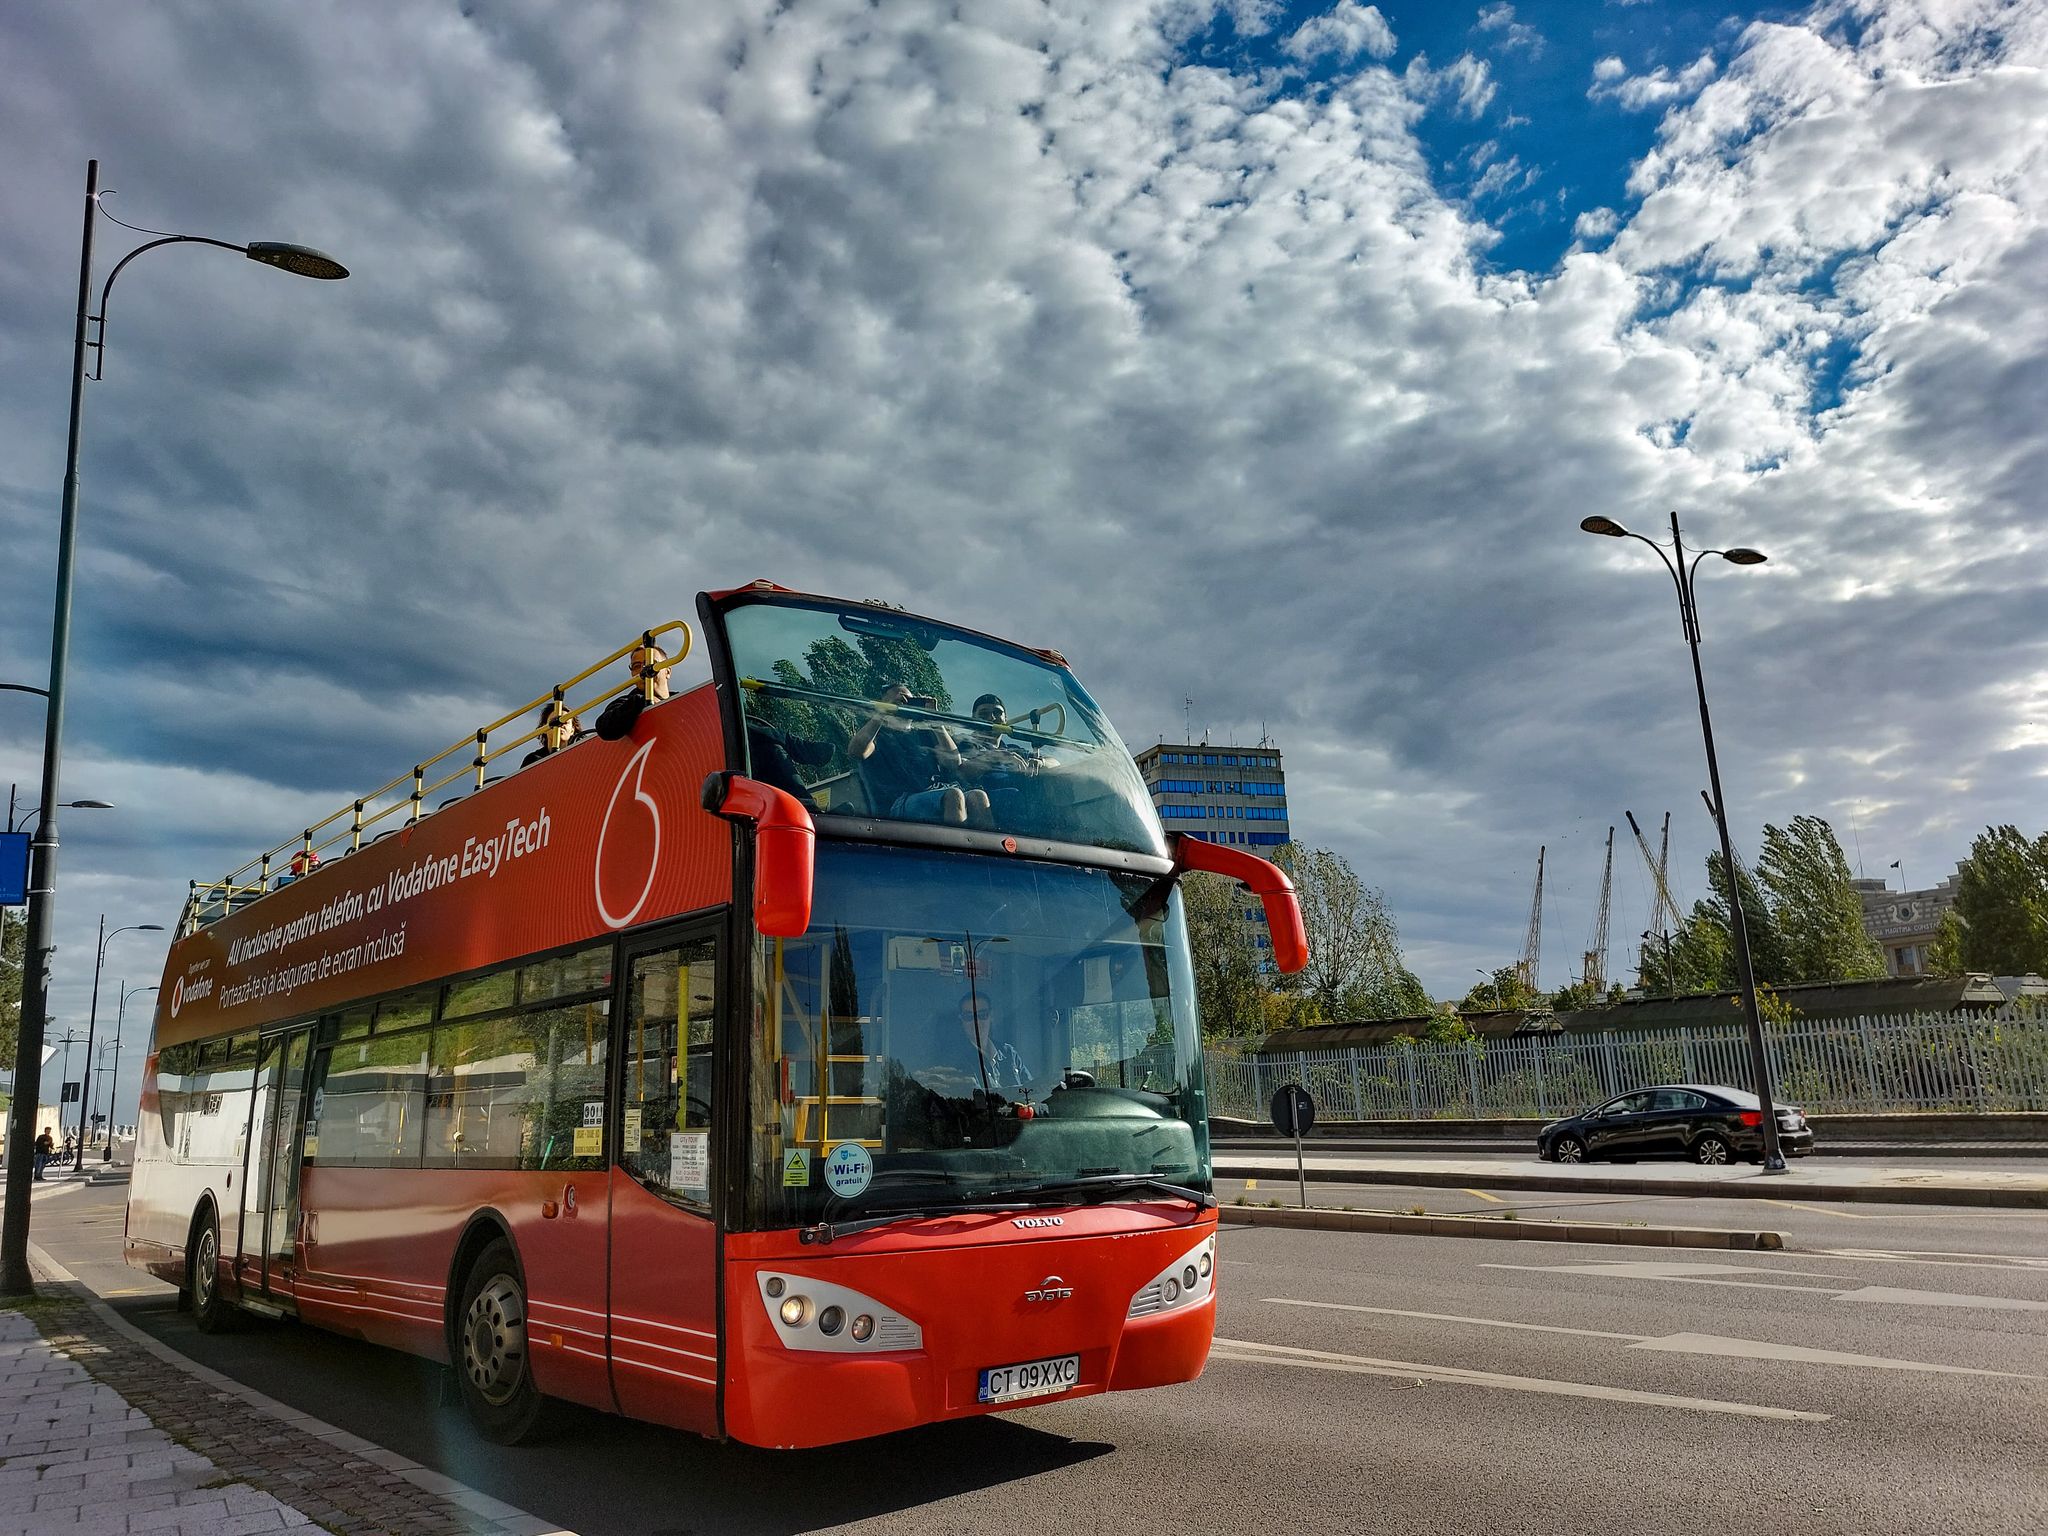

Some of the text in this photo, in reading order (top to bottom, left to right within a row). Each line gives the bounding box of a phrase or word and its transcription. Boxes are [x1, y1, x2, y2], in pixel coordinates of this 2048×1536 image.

[226, 938, 242, 968] All
[240, 924, 282, 962] inclusive
[280, 911, 319, 954] pentru
[319, 889, 364, 922] telefon,
[367, 883, 385, 913] cu
[388, 854, 459, 905] Vodafone
[460, 807, 551, 878] EasyTech
[276, 961, 317, 996] asigurare
[318, 950, 331, 979] de
[332, 945, 361, 975] ecran
[363, 921, 407, 966] inclusă
[183, 976, 213, 1003] vodafone
[834, 1163, 865, 1175] Wi-Fi
[836, 1177, 862, 1187] gratuit
[1012, 1217, 1064, 1229] VOLVO
[979, 1386, 988, 1396] RO
